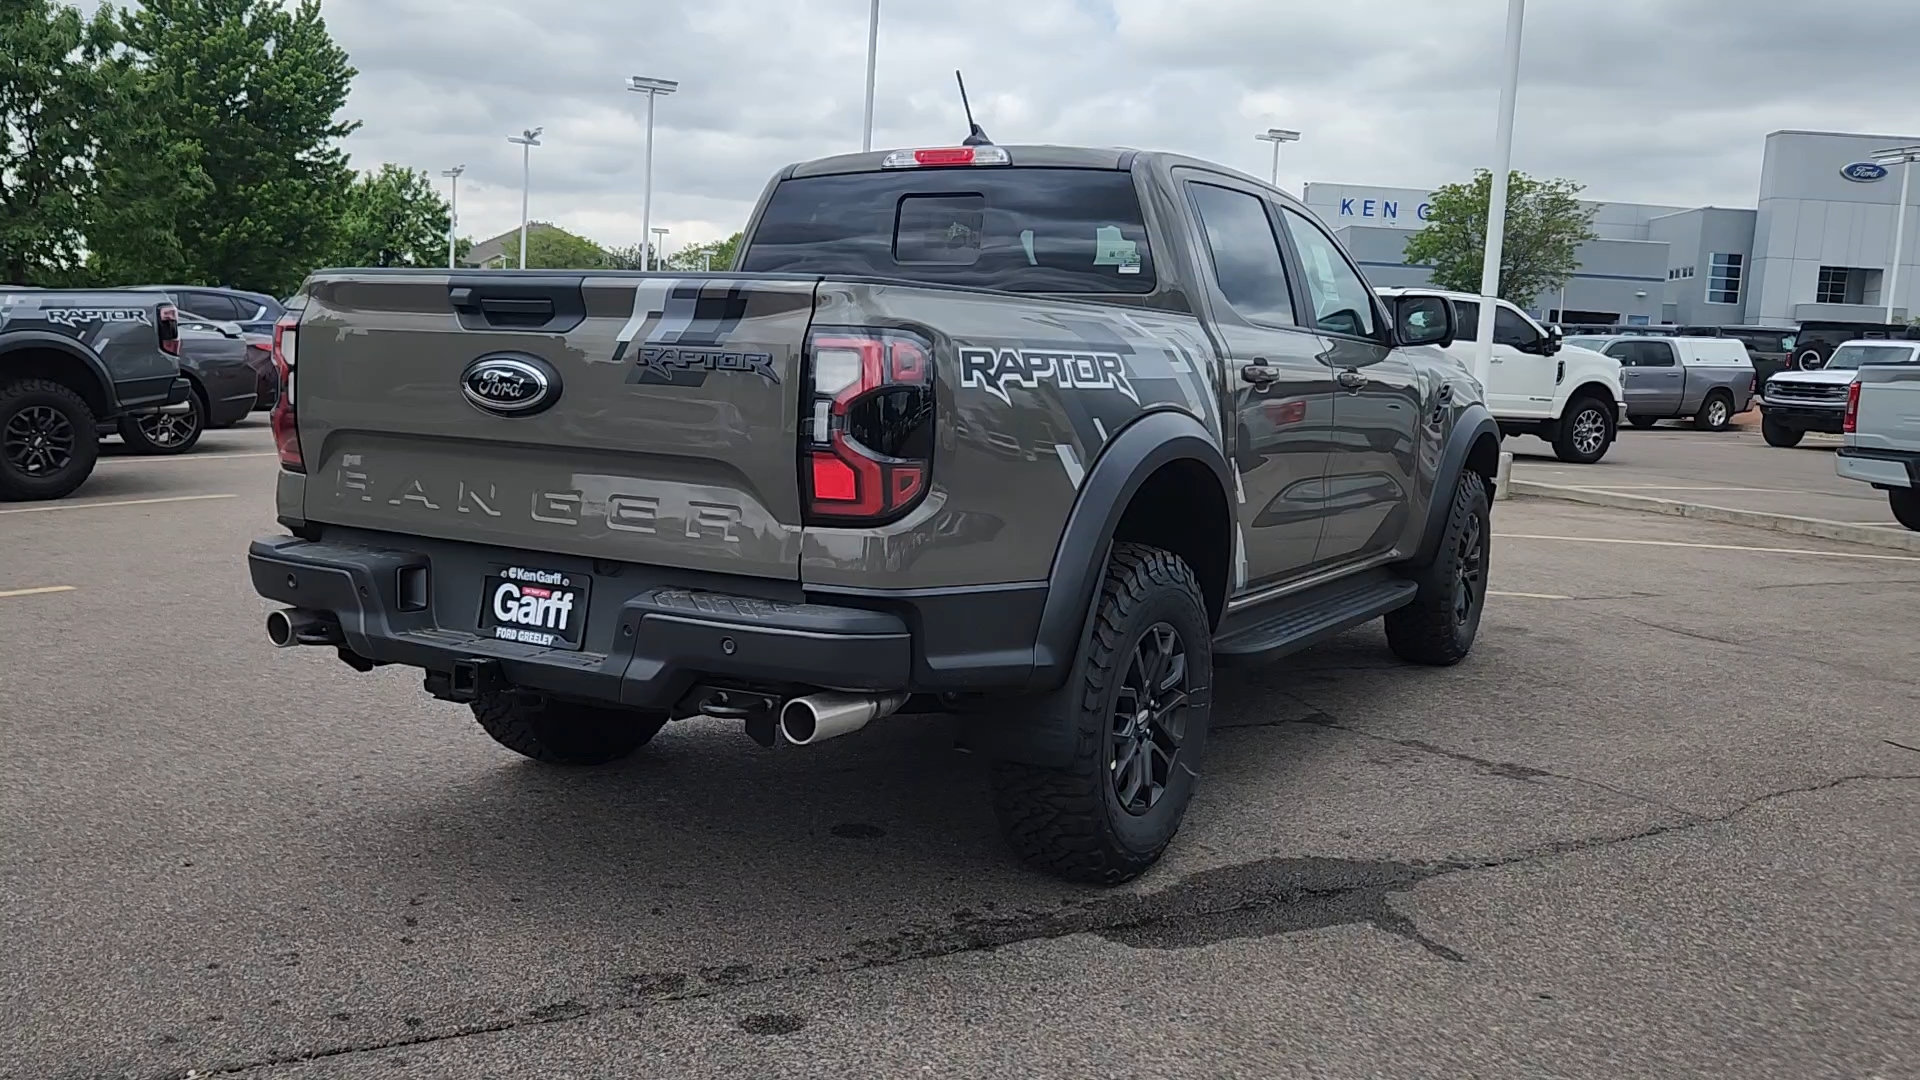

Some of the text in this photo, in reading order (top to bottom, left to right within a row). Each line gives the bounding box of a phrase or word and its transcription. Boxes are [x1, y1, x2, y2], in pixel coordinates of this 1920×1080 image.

[1341, 198, 1398, 219] KEN
[46, 308, 152, 328] RAPTOR
[636, 347, 780, 385] RAPTOR
[958, 346, 1141, 408] RAPTOR
[478, 369, 525, 397] Ford
[334, 466, 741, 543] RANGER
[494, 583, 574, 630] Garff
[496, 627, 555, 646] FORD GREELEY
